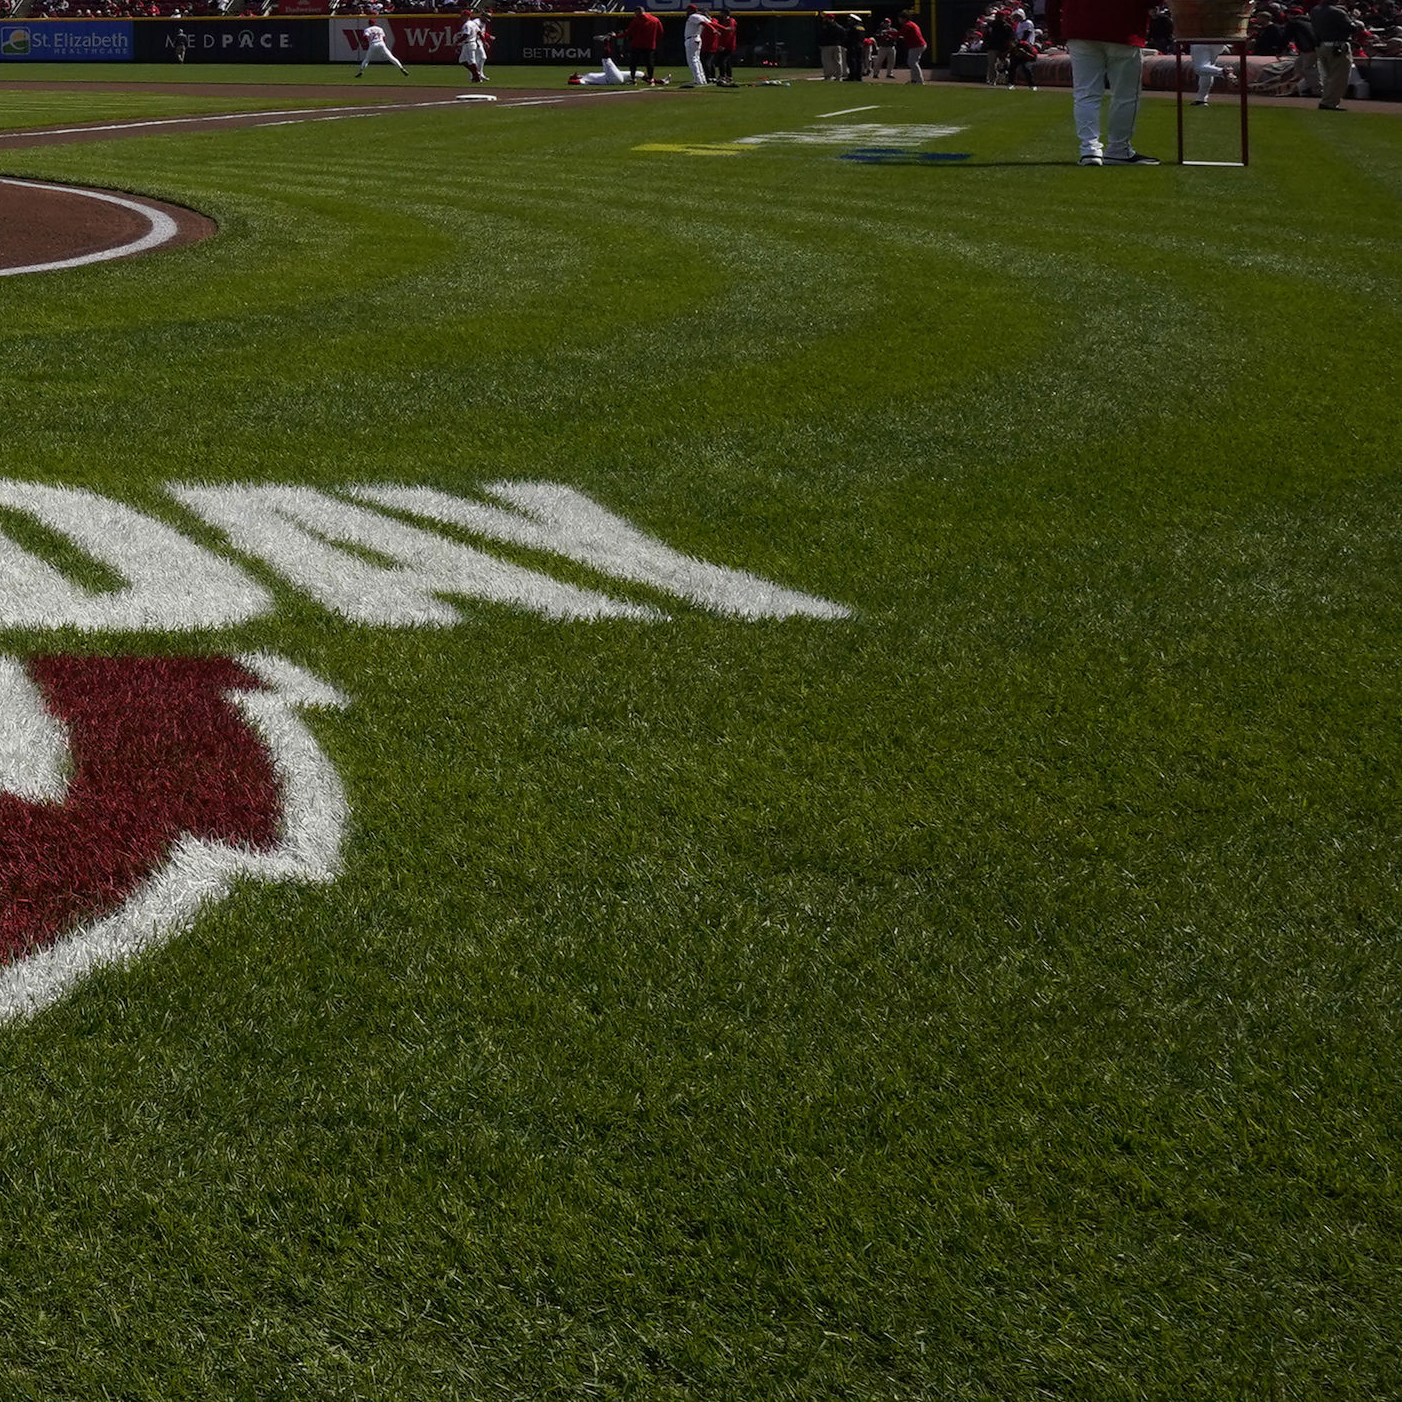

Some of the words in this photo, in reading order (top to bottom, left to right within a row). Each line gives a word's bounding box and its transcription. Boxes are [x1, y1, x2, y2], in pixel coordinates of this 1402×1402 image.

[32, 33, 52, 47] St.
[54, 32, 128, 47] Elizabeth
[404, 27, 466, 54] Wyle
[523, 48, 591, 58] BETMGM
